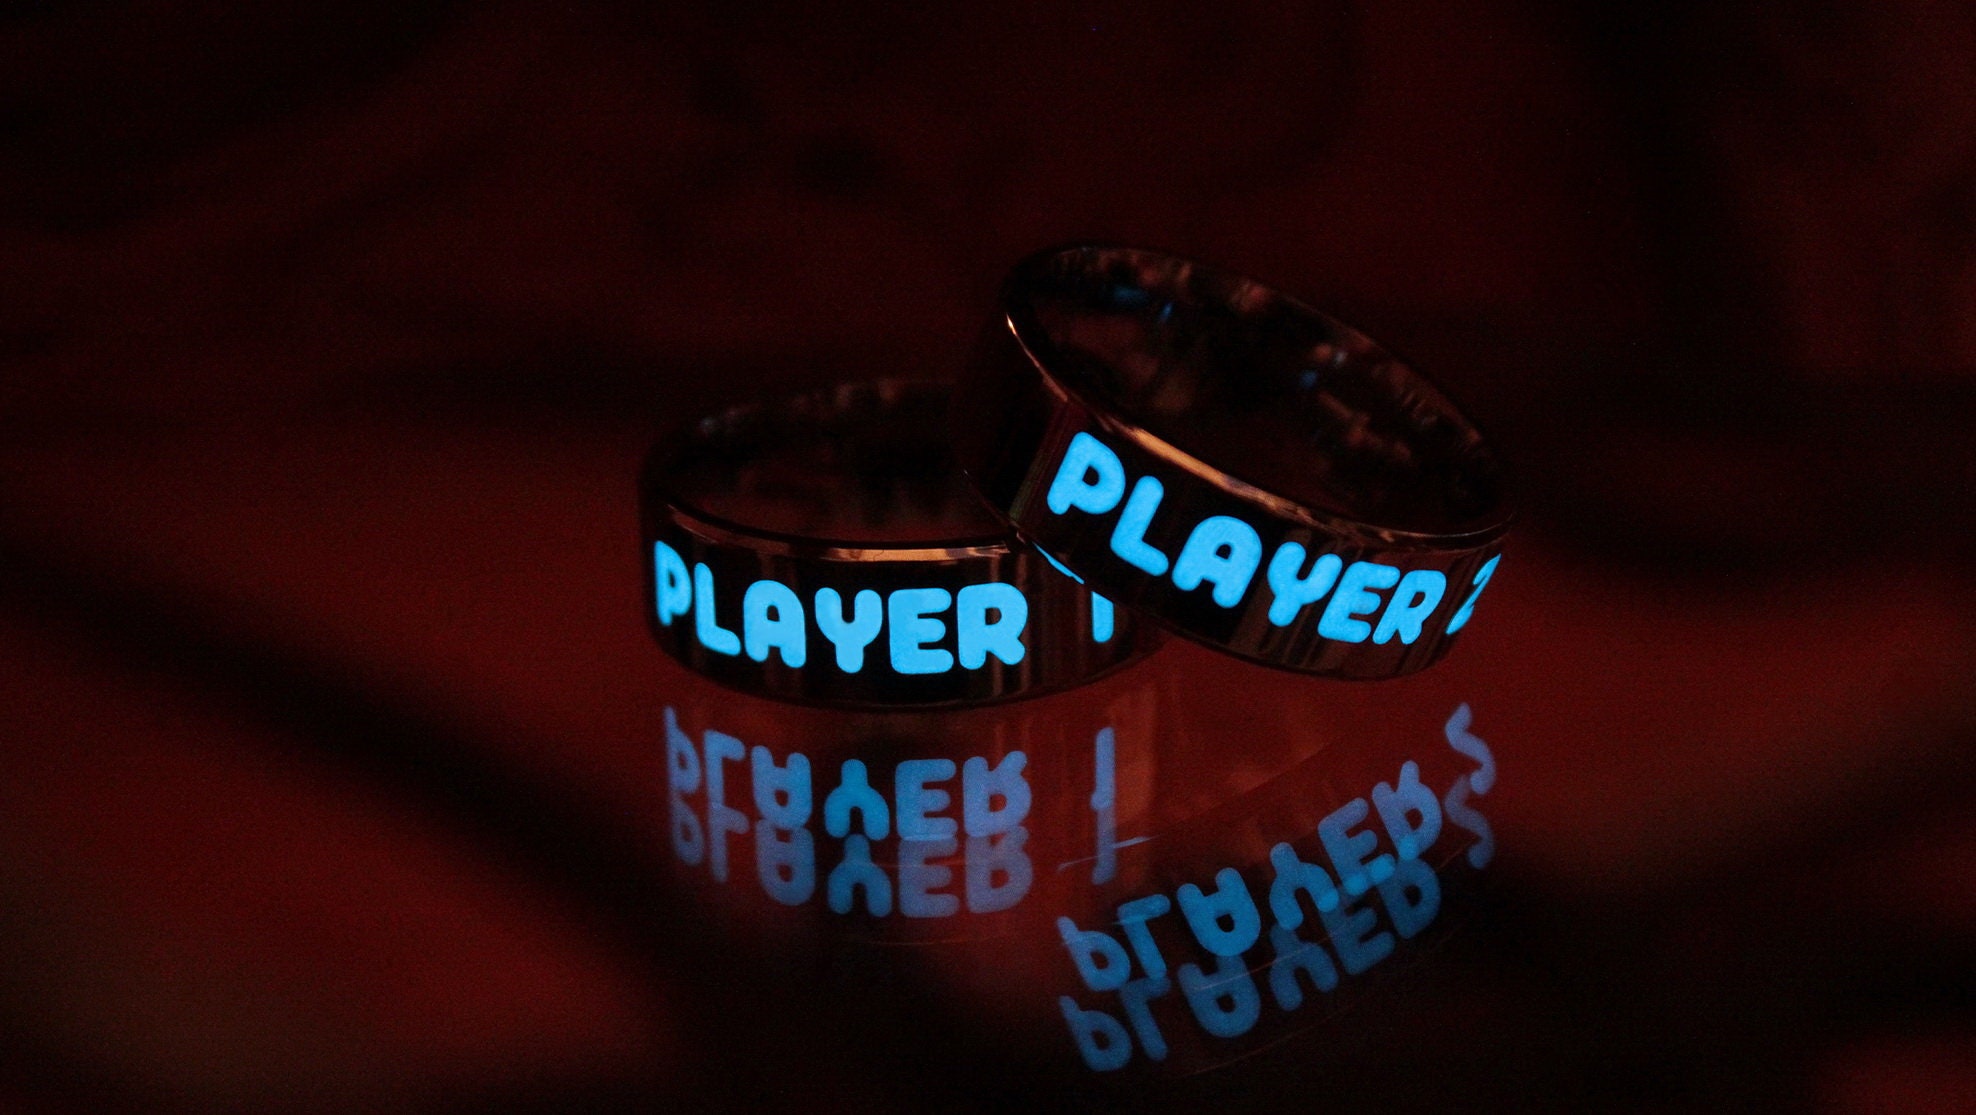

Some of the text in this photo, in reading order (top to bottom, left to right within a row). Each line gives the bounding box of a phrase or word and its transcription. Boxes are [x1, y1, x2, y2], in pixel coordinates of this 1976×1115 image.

[653, 539, 1029, 676] PLAYER
[1046, 431, 1502, 646] PLAYER 2
